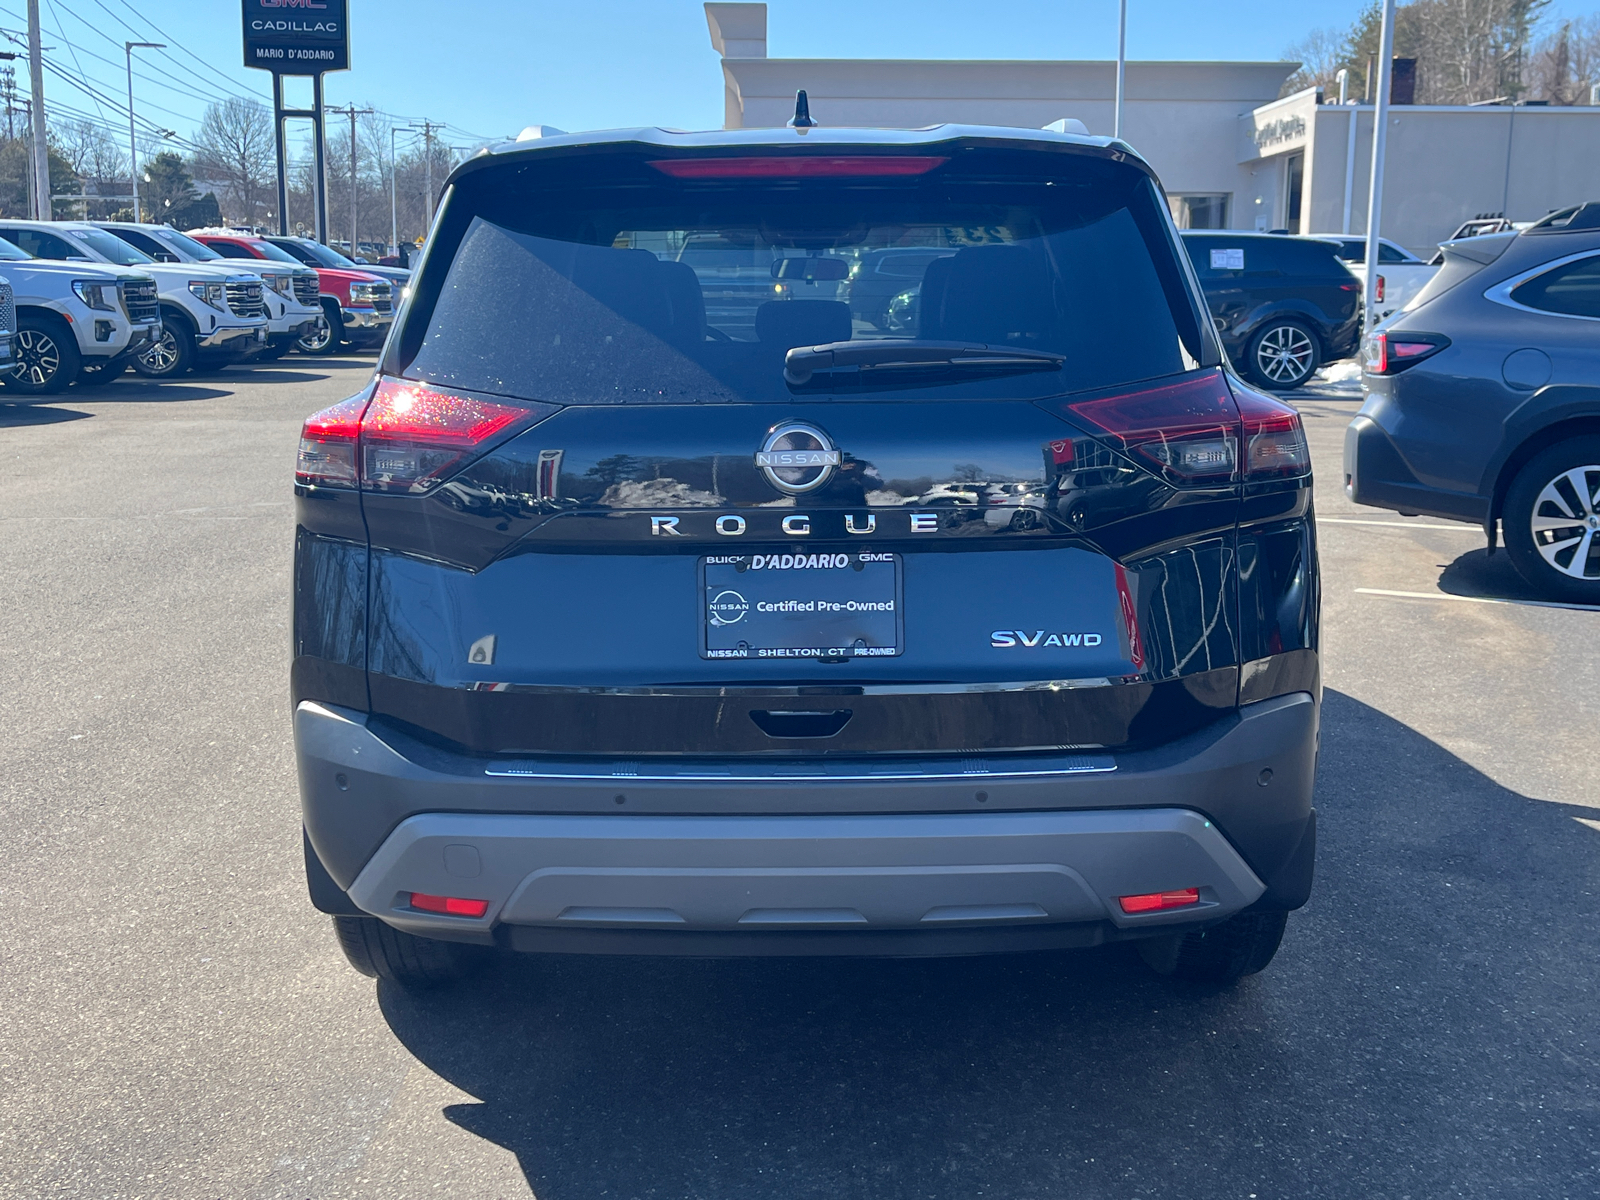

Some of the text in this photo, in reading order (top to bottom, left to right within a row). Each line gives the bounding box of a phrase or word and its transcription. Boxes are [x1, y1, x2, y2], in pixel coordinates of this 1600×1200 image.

[251, 20, 337, 32] CADILLAC
[256, 48, 335, 60] MARIO D'ADDARIO
[759, 453, 837, 464] NISSAN
[650, 514, 938, 536] ROGUE
[751, 553, 849, 570] D'ADDARIO
[858, 553, 894, 562] GMC
[756, 600, 895, 612] Certified Pre-Owned
[991, 630, 1102, 647] SV AWD
[758, 649, 824, 657] SHELTON,
[827, 648, 847, 656] CT
[854, 647, 896, 656] PRE-OWNED
